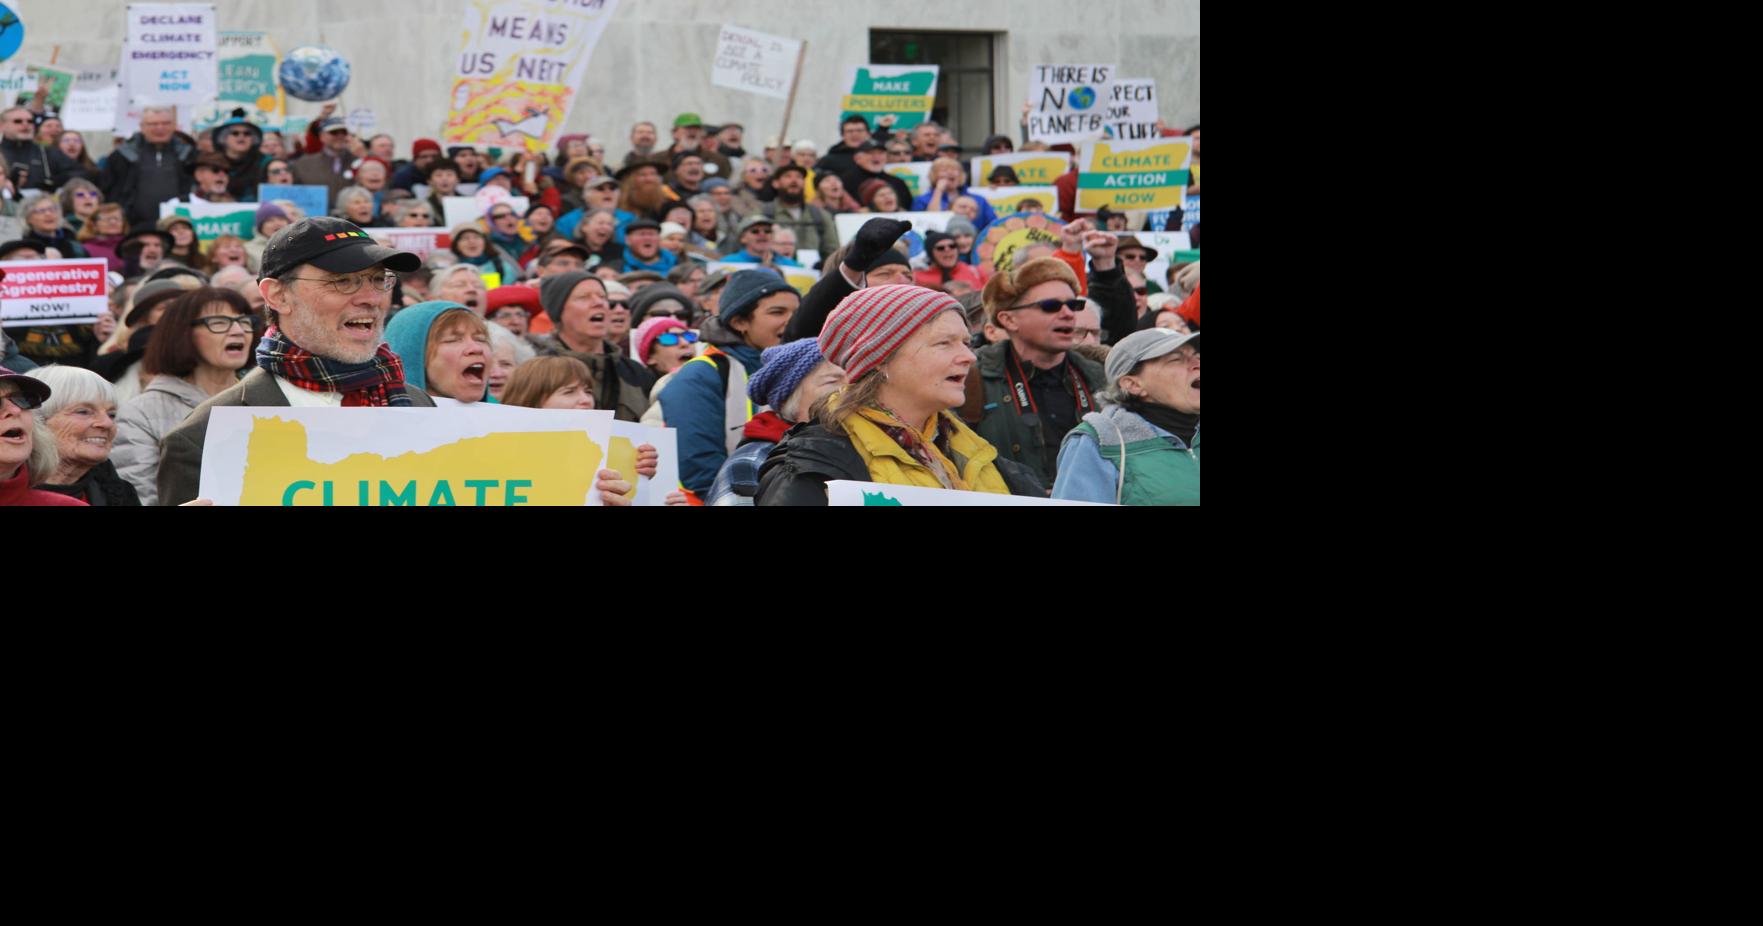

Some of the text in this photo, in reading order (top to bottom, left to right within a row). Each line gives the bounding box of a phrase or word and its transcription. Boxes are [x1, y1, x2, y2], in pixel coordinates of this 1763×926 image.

[140, 16, 203, 24] DECLARE
[488, 16, 568, 46] MEANS
[141, 34, 201, 42] CLIMATE
[131, 51, 214, 60] EMERGENCY
[461, 53, 496, 75] US
[160, 70, 189, 79] ACT
[1037, 65, 1109, 83] THERE IS
[159, 83, 191, 91] NOW
[872, 81, 911, 93] MAKE
[1102, 154, 1171, 168] CLIMATE
[1103, 172, 1168, 187] ACTION
[1114, 192, 1155, 204] NOW
[195, 221, 242, 235] MAKE
[29, 303, 71, 313] NOW!
